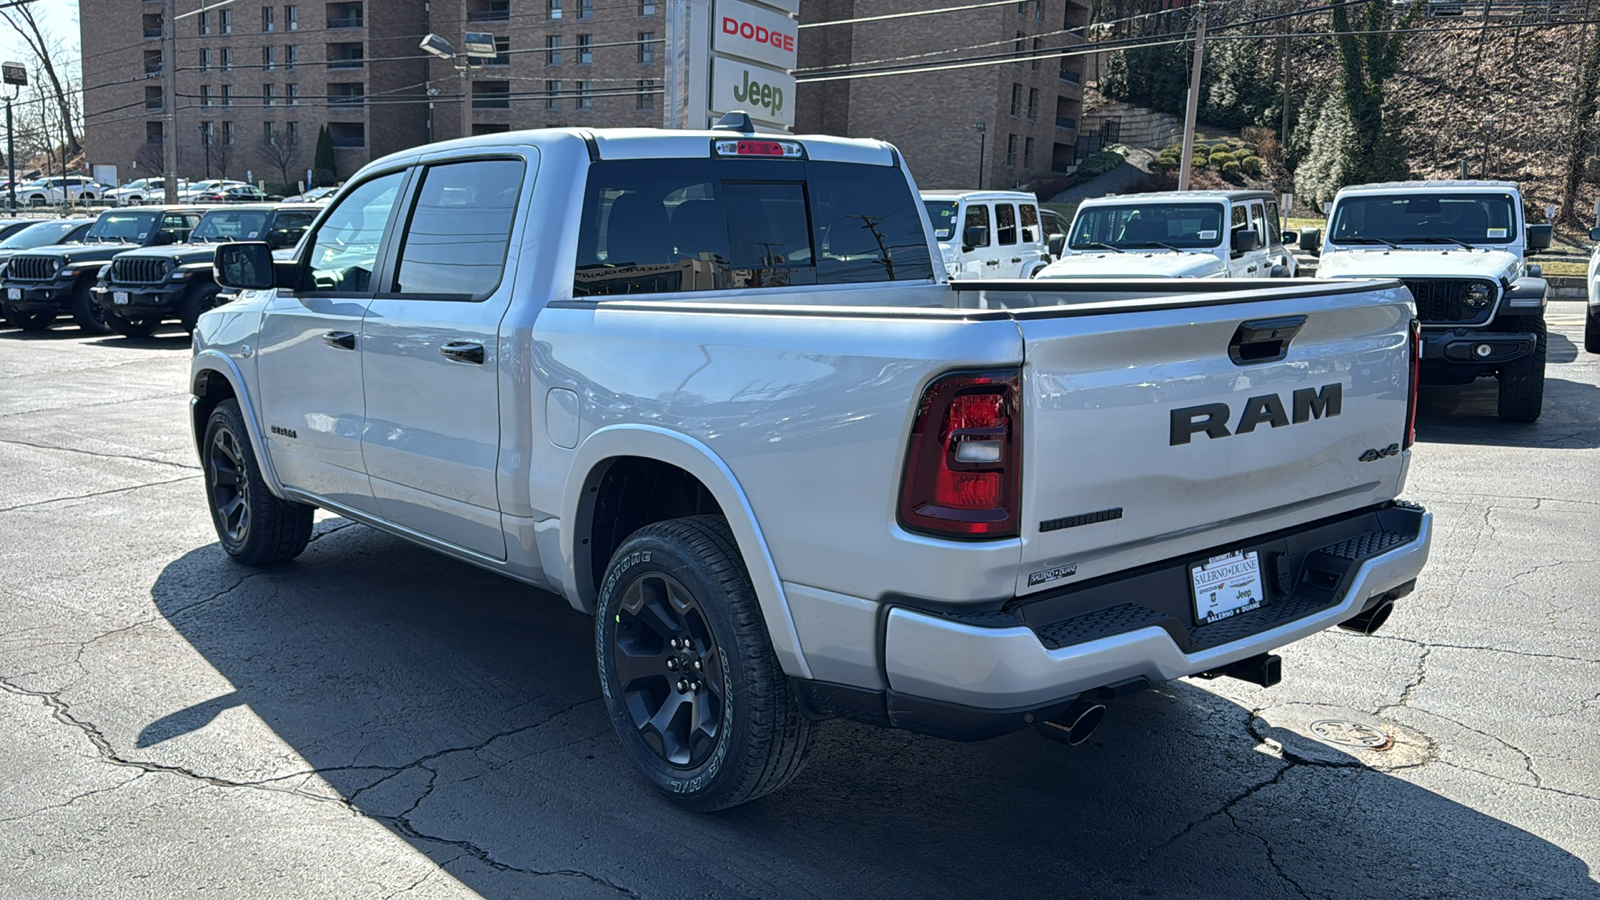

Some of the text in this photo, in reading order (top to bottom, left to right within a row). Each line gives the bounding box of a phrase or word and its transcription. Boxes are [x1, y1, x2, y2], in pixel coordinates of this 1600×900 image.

[722, 16, 794, 53] DODGE
[733, 69, 784, 117] Jeep
[1169, 382, 1343, 447] RAM
[1194, 560, 1257, 585] SALERNO DUANE
[1206, 601, 1260, 623] SALERNO DUANE
[1236, 589, 1252, 600] Jeep
[596, 551, 652, 699] BRIDGESTONE
